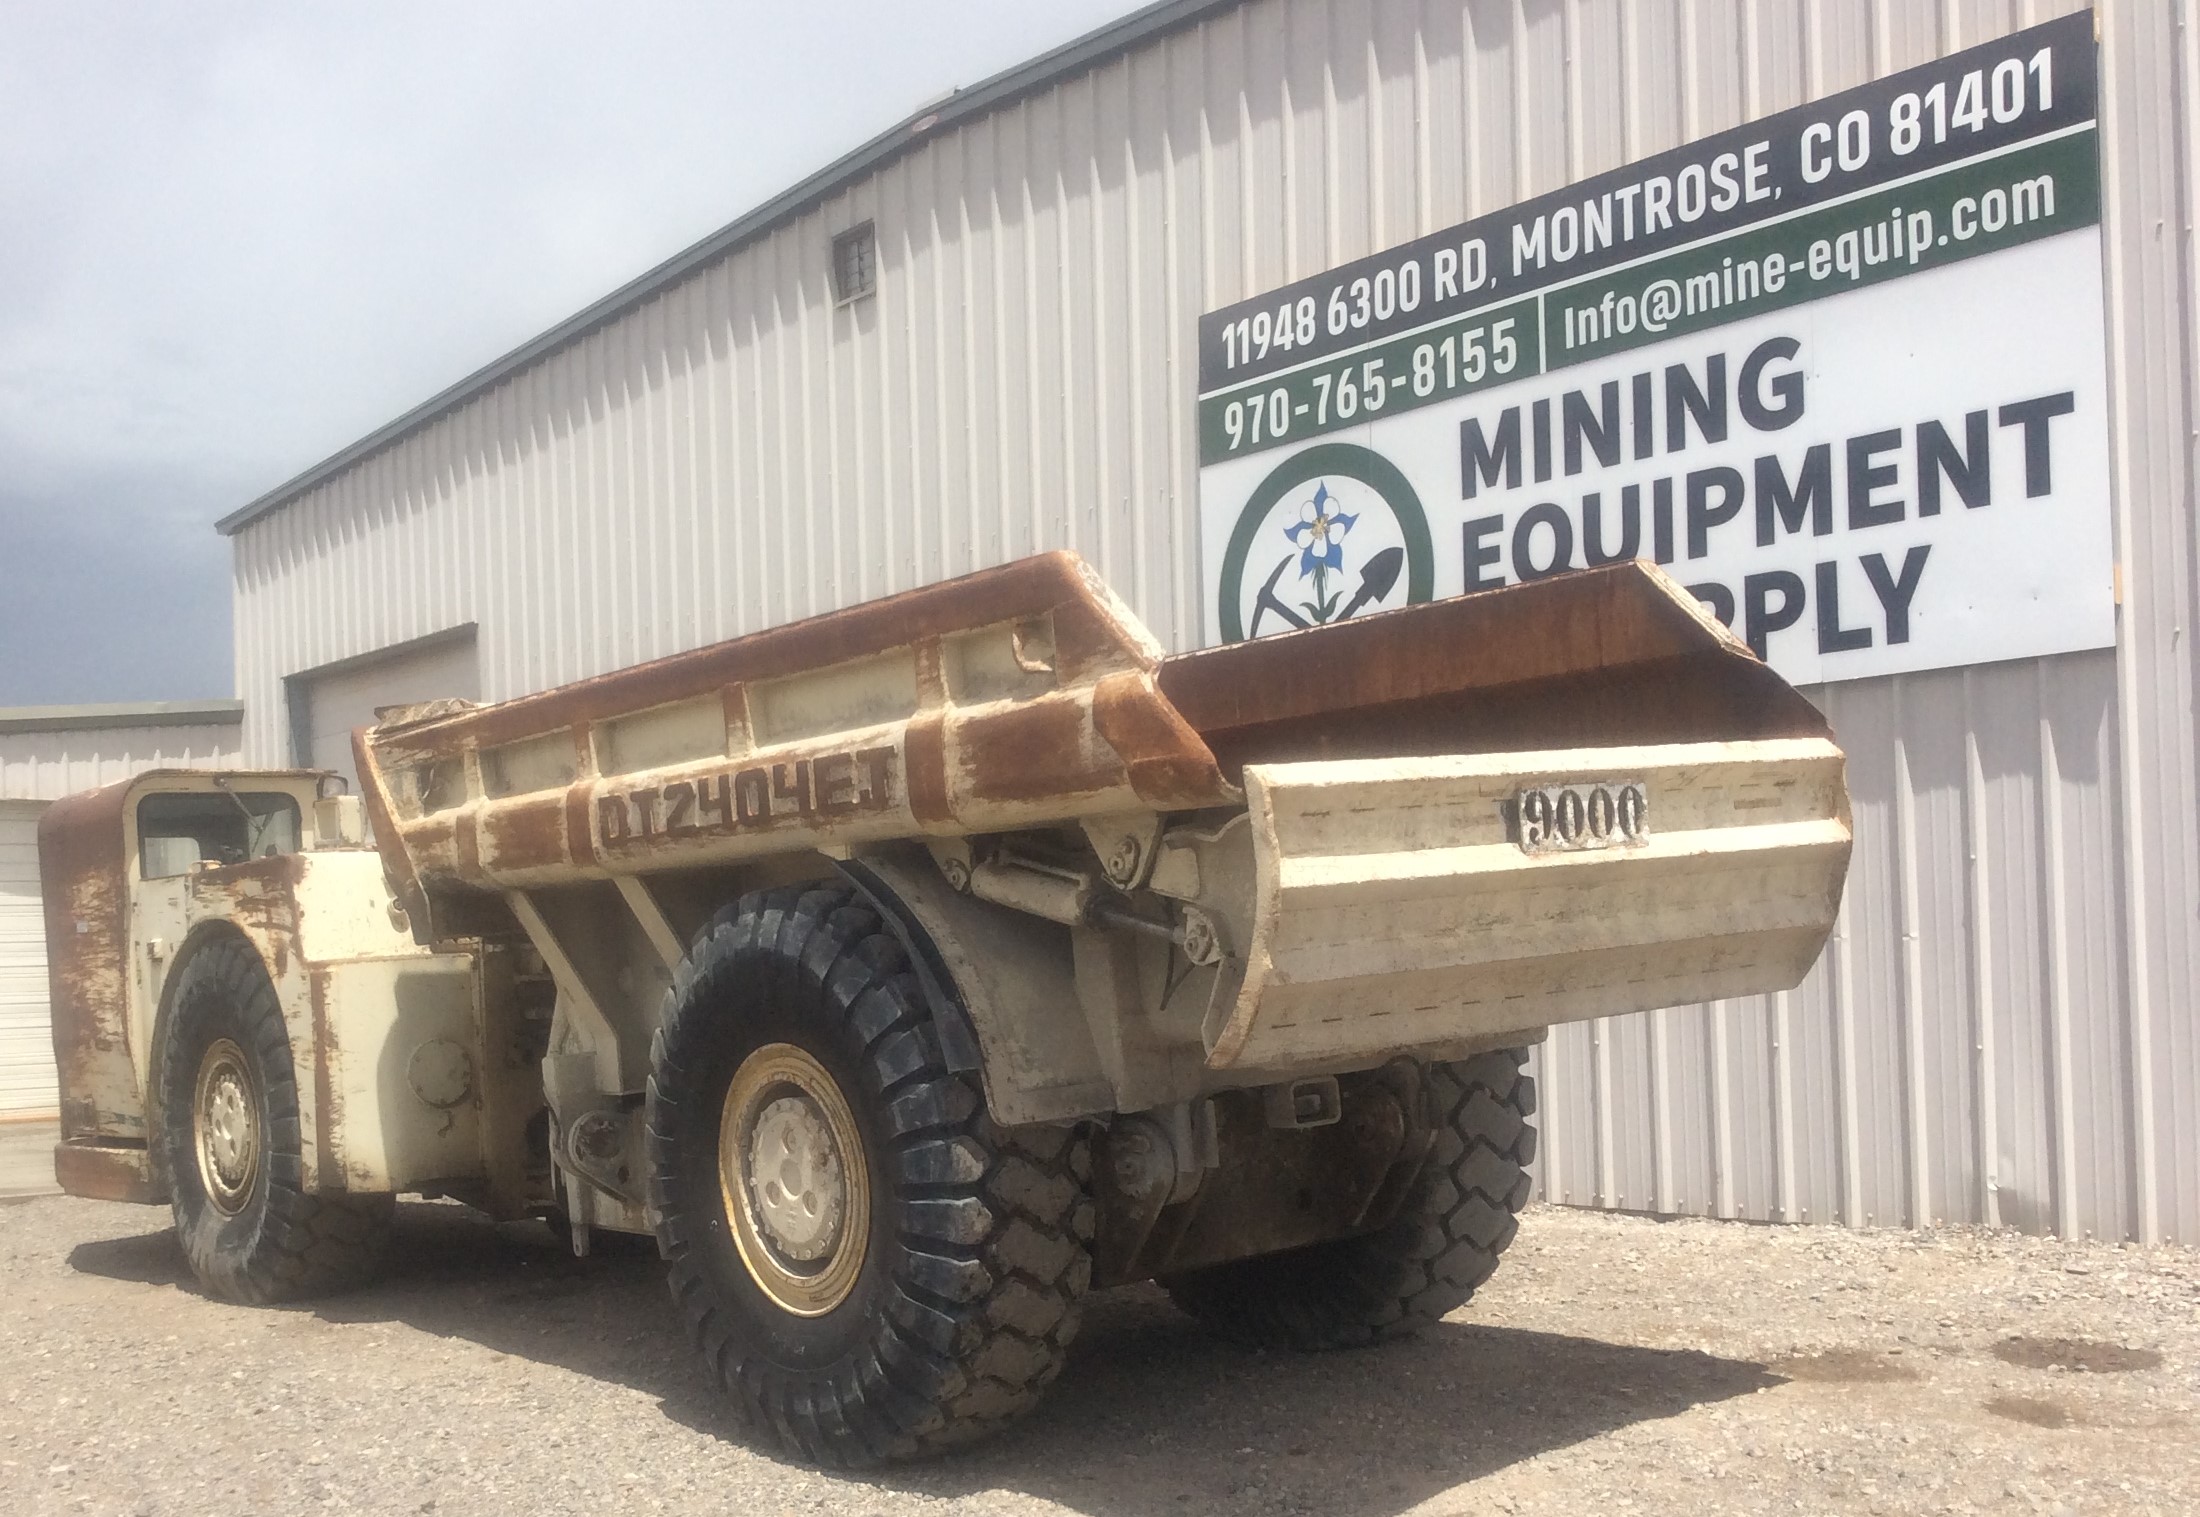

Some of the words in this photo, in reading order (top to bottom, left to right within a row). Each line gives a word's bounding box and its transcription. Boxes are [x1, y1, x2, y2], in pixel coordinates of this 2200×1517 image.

[1221, 294, 1317, 370] 11948
[1326, 260, 1422, 338] 6300
[1434, 238, 1498, 304] RD,
[1511, 142, 1783, 275] MONTROSE,
[1801, 110, 1869, 183] CO
[1889, 46, 2053, 156] 81401
[1564, 175, 2056, 349] Info@mine-equip.com
[1224, 318, 1518, 450] 970-765-8155
[1460, 336, 1805, 500] MINING
[1463, 391, 2075, 594] EQUIPMENT
[1525, 785, 1647, 846] 9000
